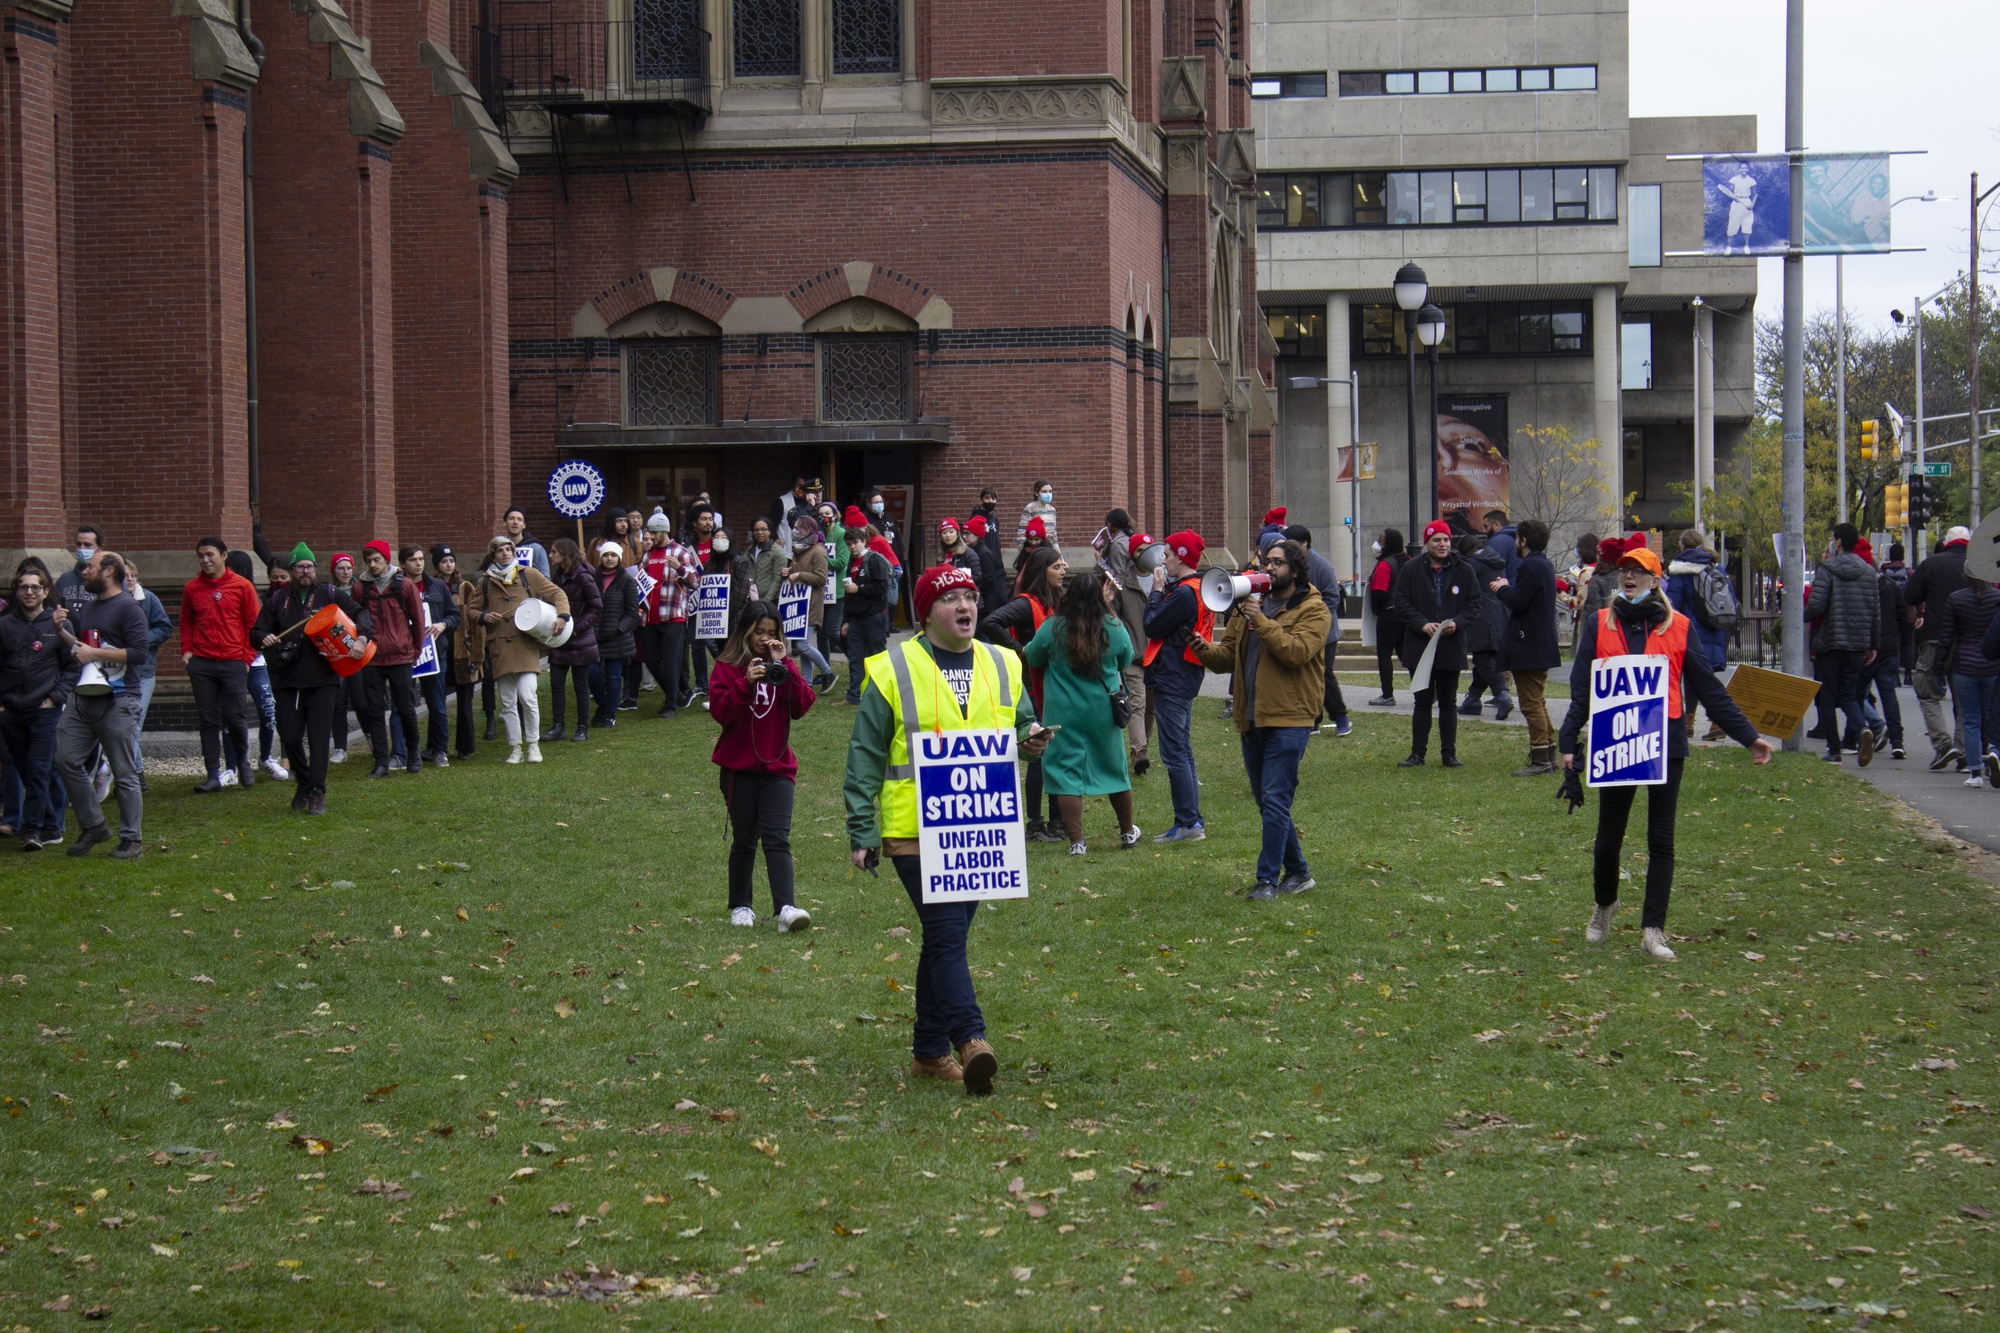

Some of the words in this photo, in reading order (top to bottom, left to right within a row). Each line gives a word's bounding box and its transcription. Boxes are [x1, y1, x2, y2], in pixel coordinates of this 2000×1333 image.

[1452, 404, 1492, 412] Interrogative
[1913, 465, 1935, 473] QNCY
[1941, 465, 1948, 473] ST
[564, 483, 588, 497] UAW
[637, 571, 653, 592] UAW
[702, 576, 728, 586] UAW
[706, 588, 718, 598] ON
[781, 583, 809, 598] UAW
[700, 598, 727, 608] STRIKE
[786, 603, 798, 618] ON
[701, 611, 723, 619] UNFAIR
[702, 619, 721, 627] LABOR
[782, 615, 806, 633] TRIKE
[697, 627, 726, 635] PRACTICE
[941, 669, 974, 681] GANIZE
[1595, 666, 1662, 699] UAW
[1612, 706, 1639, 740] ON
[922, 734, 1010, 760] UAW
[1592, 730, 1661, 779] STRIKE
[951, 765, 987, 792] ON
[926, 791, 1016, 821] STRIKE
[938, 829, 1007, 850] UNFAIR
[943, 850, 1005, 871] LABOR
[930, 870, 1021, 893] PRACTICE
